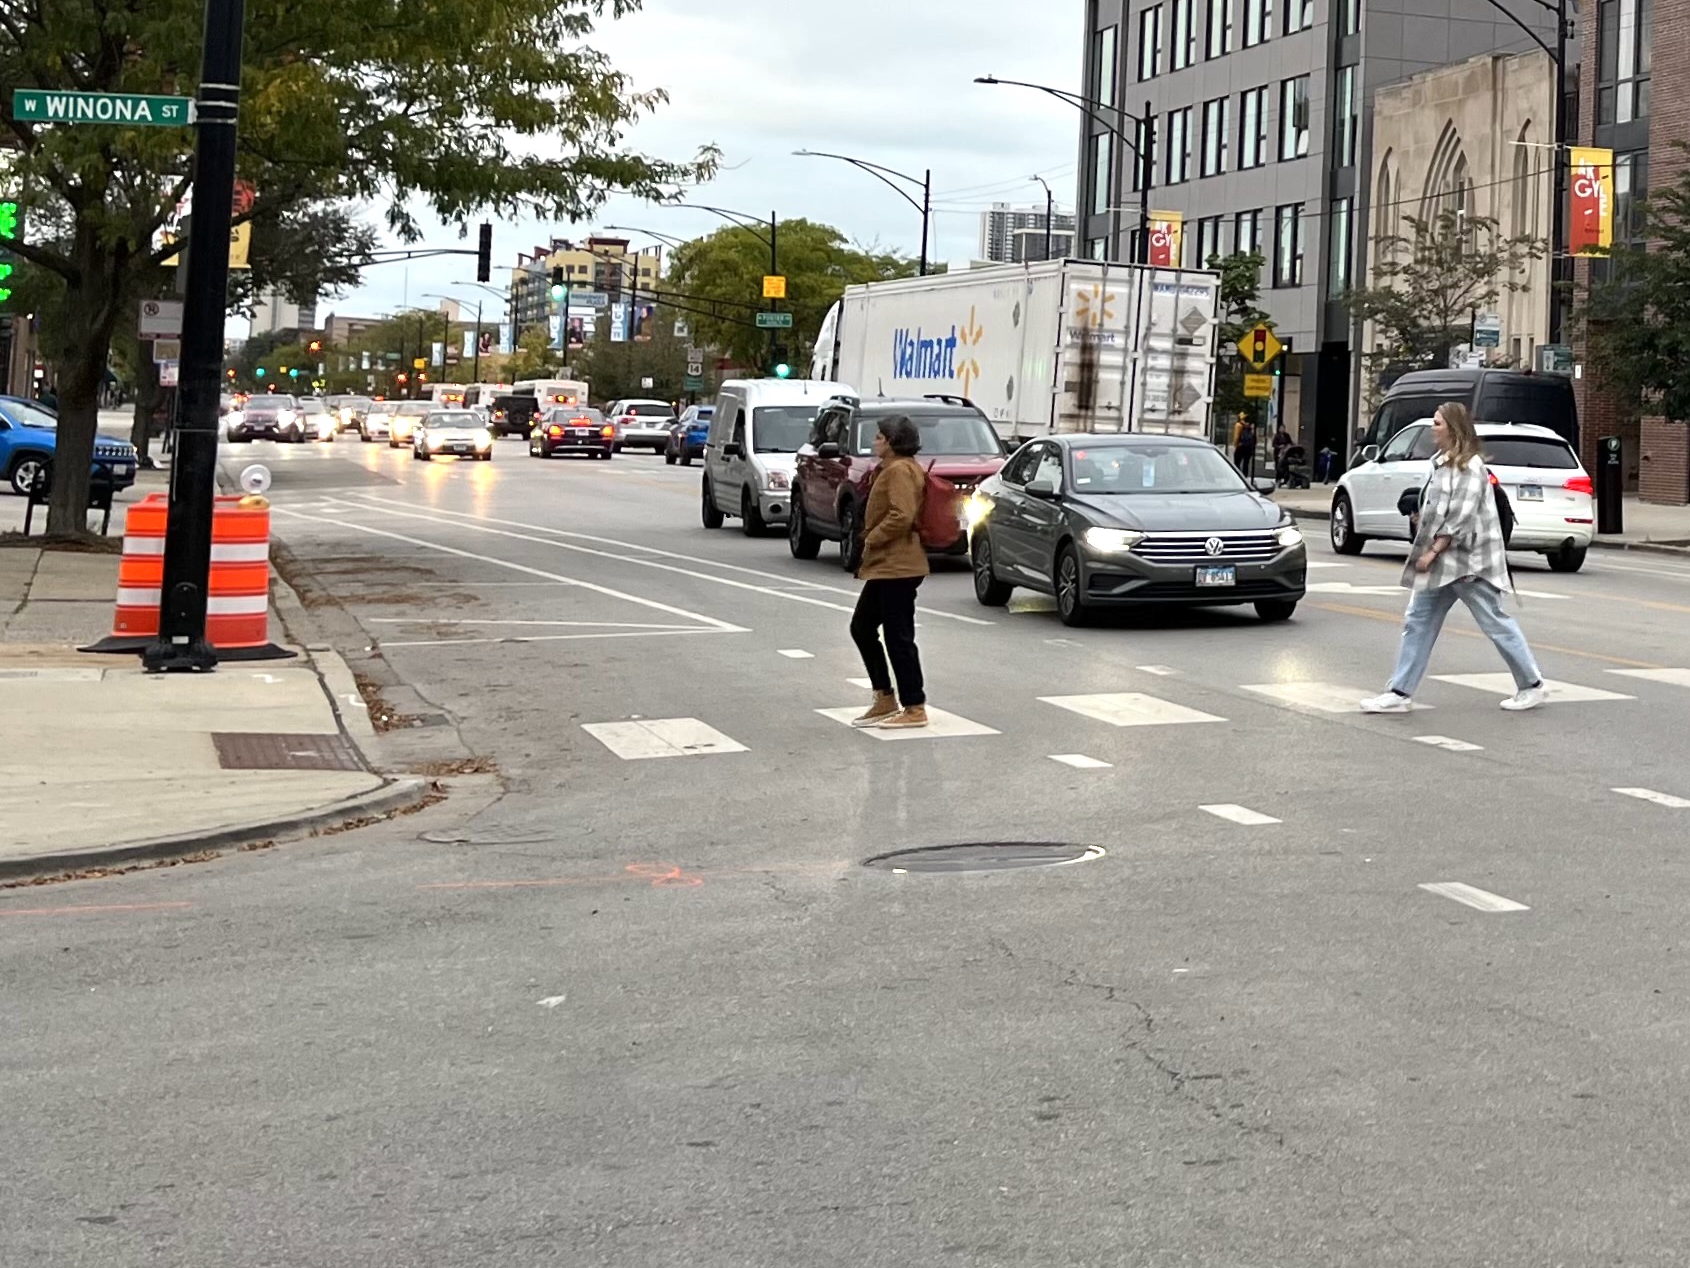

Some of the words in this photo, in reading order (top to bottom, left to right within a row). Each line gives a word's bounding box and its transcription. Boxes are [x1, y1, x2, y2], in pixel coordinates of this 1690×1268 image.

[24, 98, 37, 112] W
[46, 95, 153, 122] WINONA
[161, 104, 179, 119] ST
[893, 324, 957, 380] Walmart
